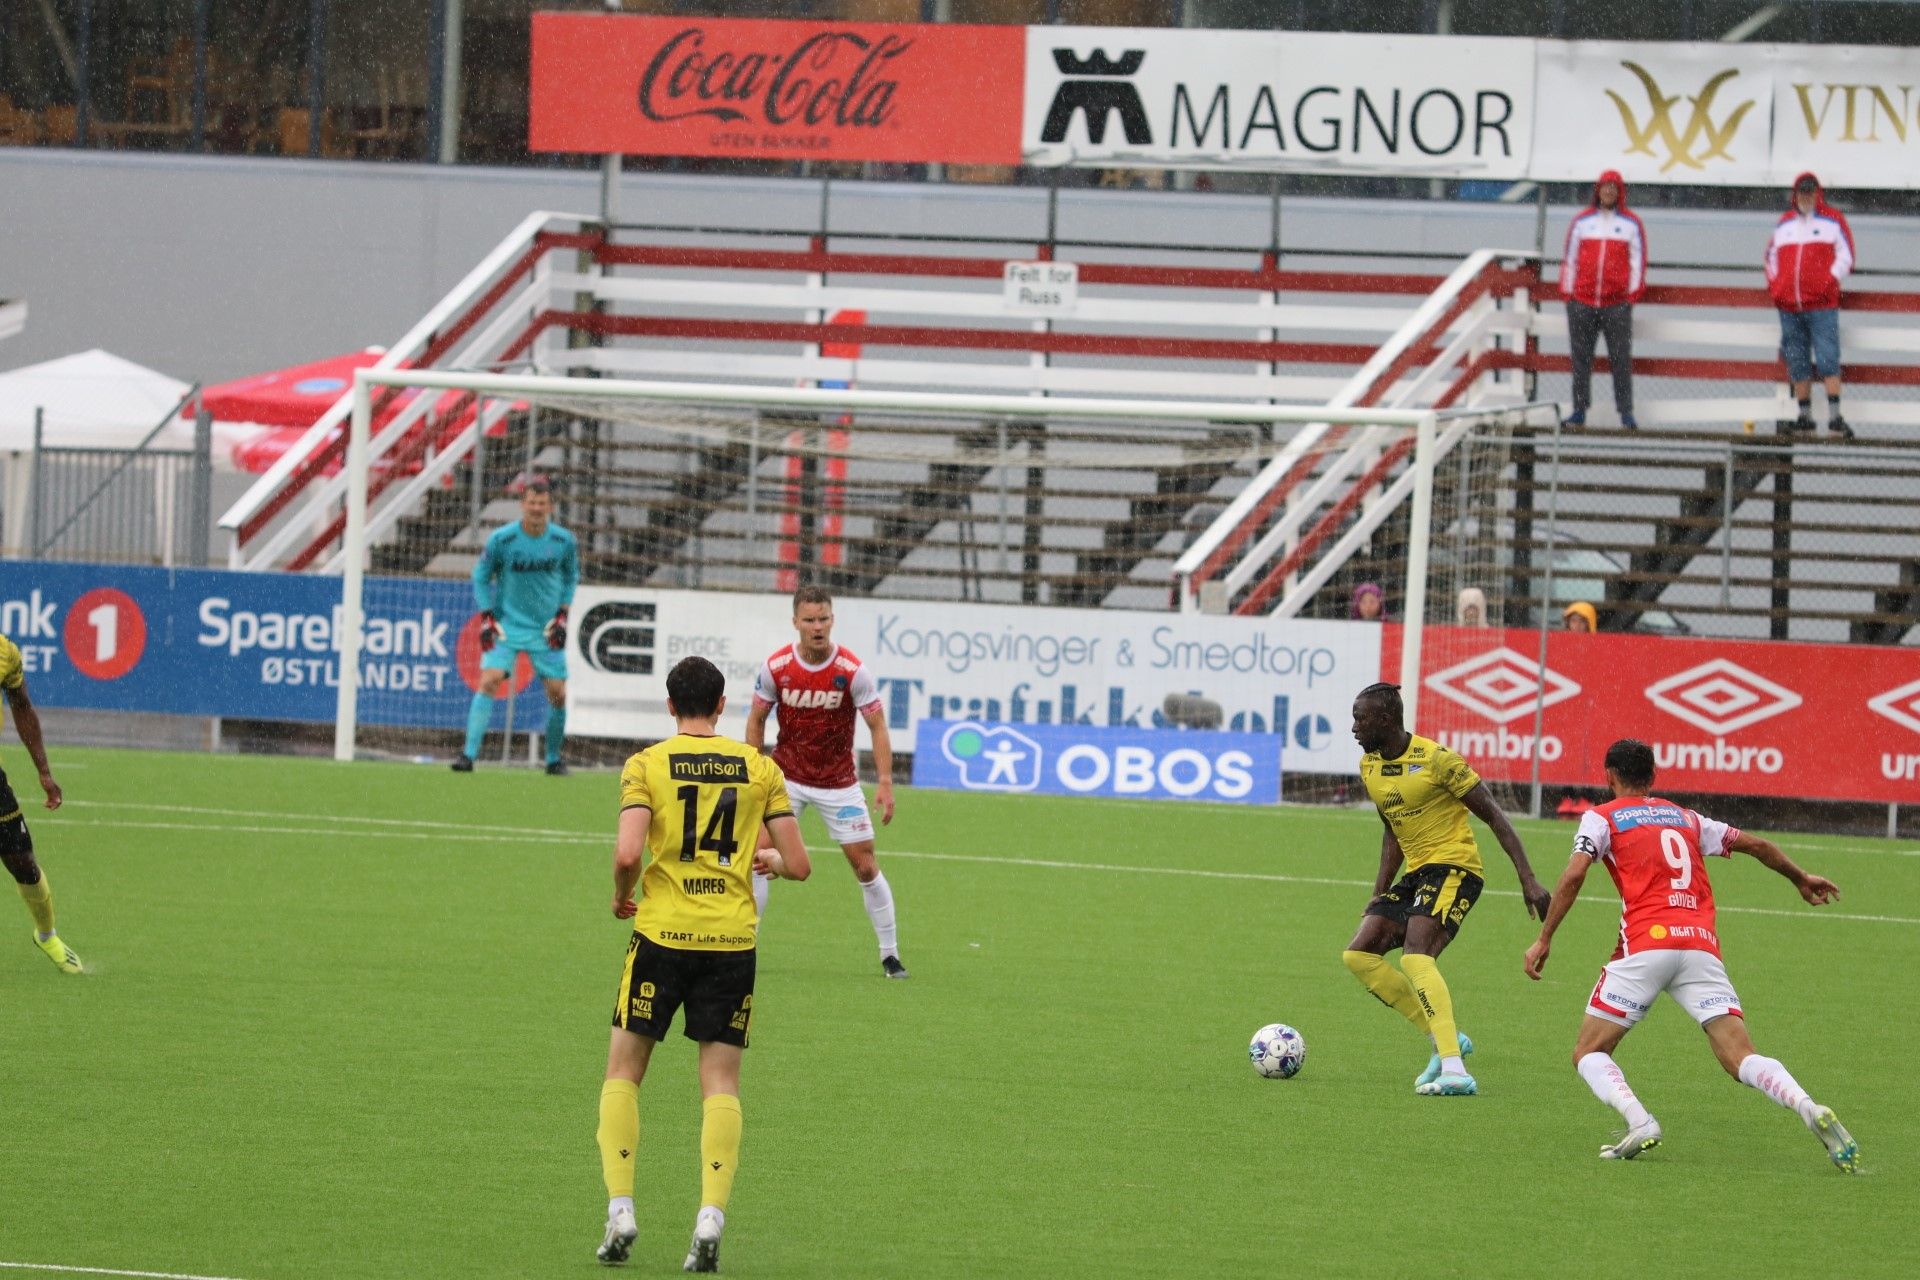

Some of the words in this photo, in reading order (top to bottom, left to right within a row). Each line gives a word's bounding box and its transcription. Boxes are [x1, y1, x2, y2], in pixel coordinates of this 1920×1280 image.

[1170, 83, 1514, 157] MAGNOR
[1792, 82, 1920, 142] VIN
[1009, 264, 1040, 282] Felt
[1048, 267, 1075, 284] for
[1020, 287, 1062, 304] Russ
[88, 603, 119, 663] 1
[876, 615, 1100, 677] Kongsvinger
[1117, 638, 1136, 667] &
[1151, 627, 1335, 688] Smedtorp
[261, 656, 450, 691] ØSTLNDET
[781, 688, 844, 709] MAPEI
[1438, 725, 1562, 761] umbro
[1653, 738, 1783, 774] umbro
[675, 758, 741, 776] murisør
[1056, 744, 1254, 797] OBOS
[677, 784, 738, 867] 14
[1614, 806, 1680, 822] SpareBank
[1661, 829, 1692, 889] 9
[683, 878, 725, 895] MARES
[660, 931, 693, 942] START
[698, 934, 716, 943] Life
[1669, 926, 1695, 937] RIGHT
